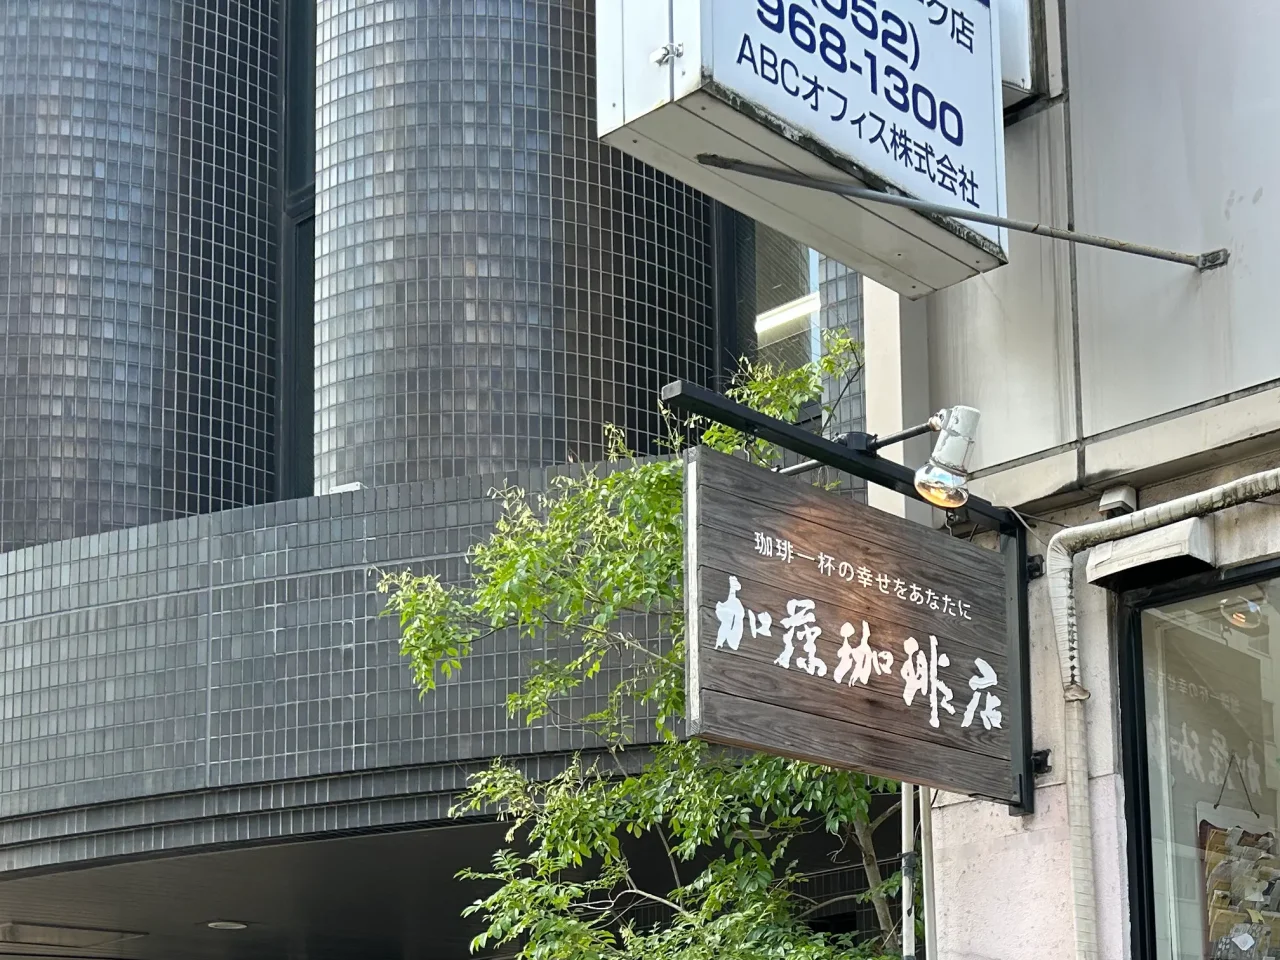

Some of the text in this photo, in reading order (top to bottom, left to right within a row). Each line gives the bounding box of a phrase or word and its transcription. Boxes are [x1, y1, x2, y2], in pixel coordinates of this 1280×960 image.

[757, 0, 964, 148] 968-1300
[812, 0, 920, 71] 52)
[918, 0, 975, 54] ク店
[737, 34, 980, 209] ABCオフィス株式会社
[754, 531, 973, 621] 珈琲一杯の幸せをあなたに
[714, 575, 1003, 731] 加藤珈琲店
